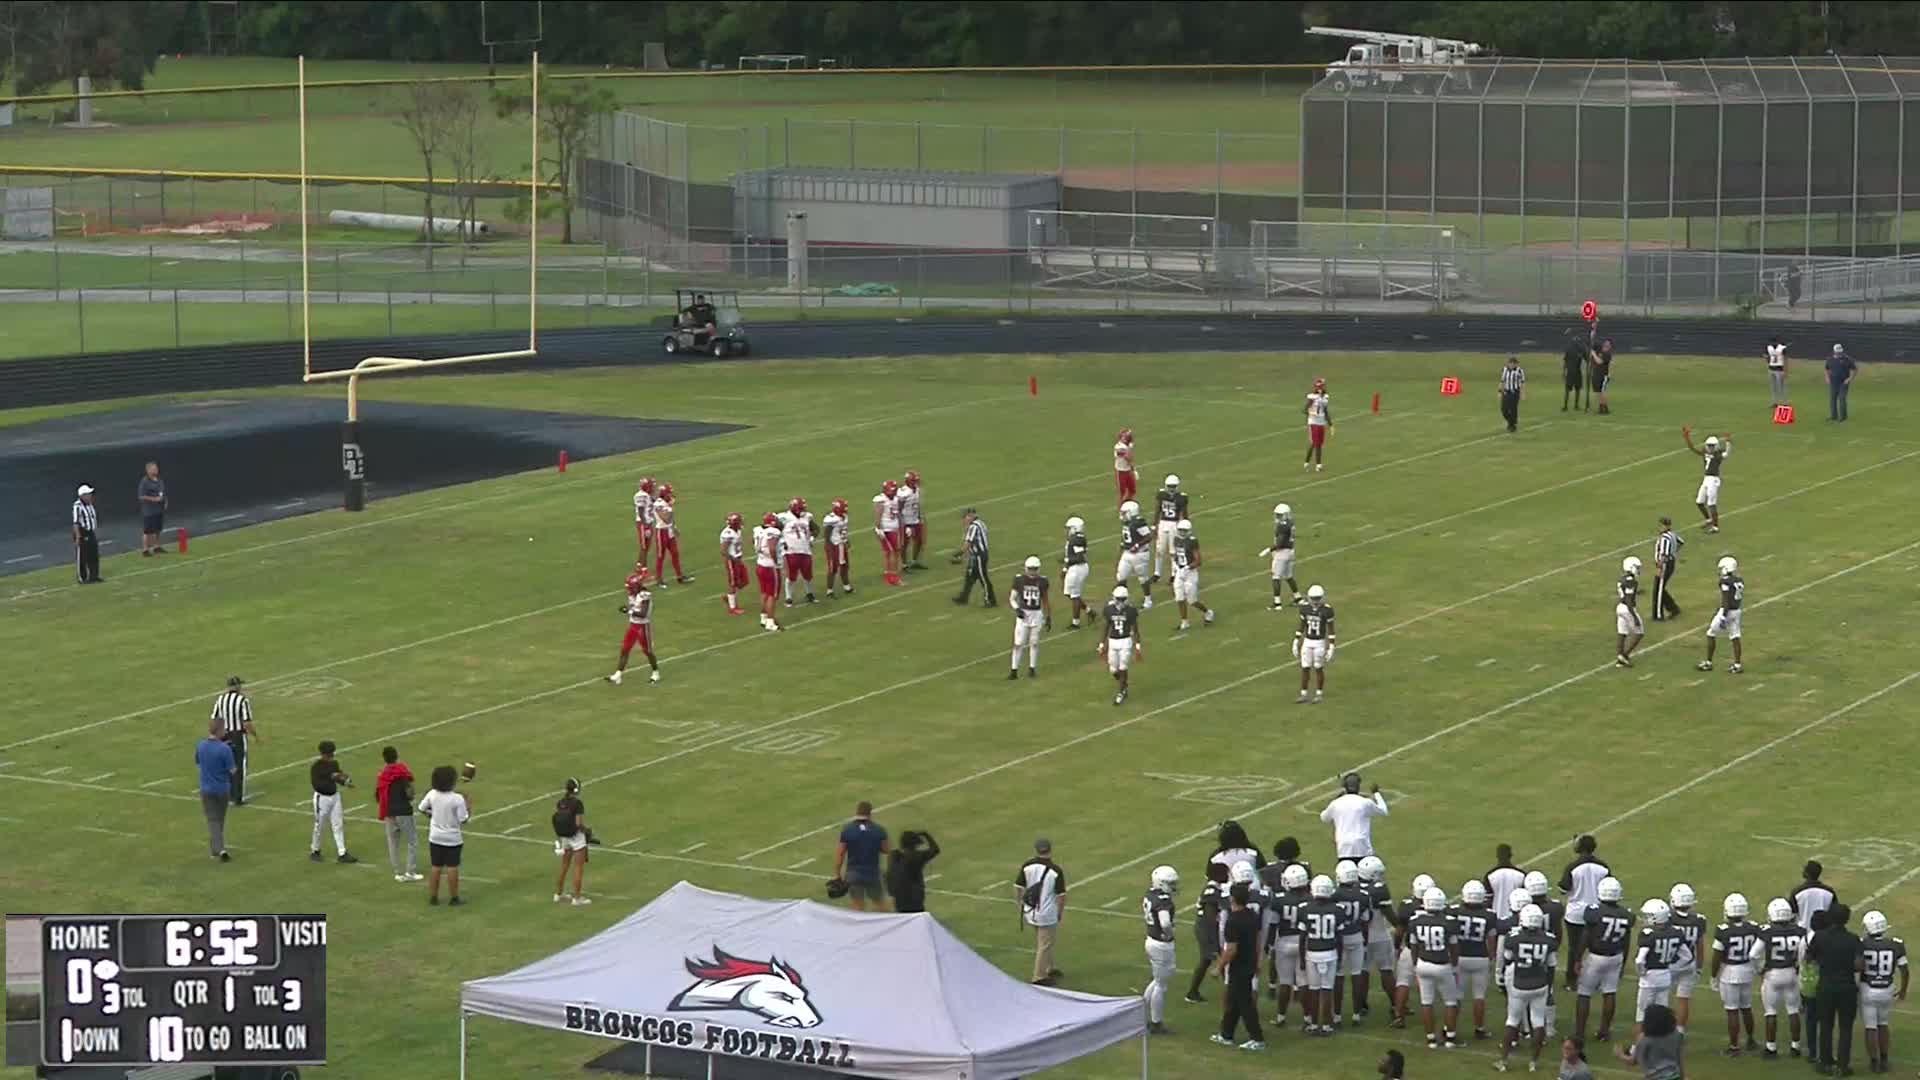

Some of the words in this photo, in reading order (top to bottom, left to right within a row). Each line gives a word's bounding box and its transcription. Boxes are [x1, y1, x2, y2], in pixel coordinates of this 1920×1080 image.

[1023, 590, 1041, 606] 44
[1114, 621, 1124, 635] 4
[1307, 914, 1335, 939] 30
[1416, 925, 1445, 951] 48
[1457, 915, 1487, 941] 33
[1602, 917, 1628, 942] 75
[1518, 943, 1548, 968] 54
[1771, 936, 1800, 960] 29
[1863, 950, 1893, 976] 28
[564, 1004, 694, 1047] BRONCOS
[702, 1024, 856, 1068] FOOTBALL
